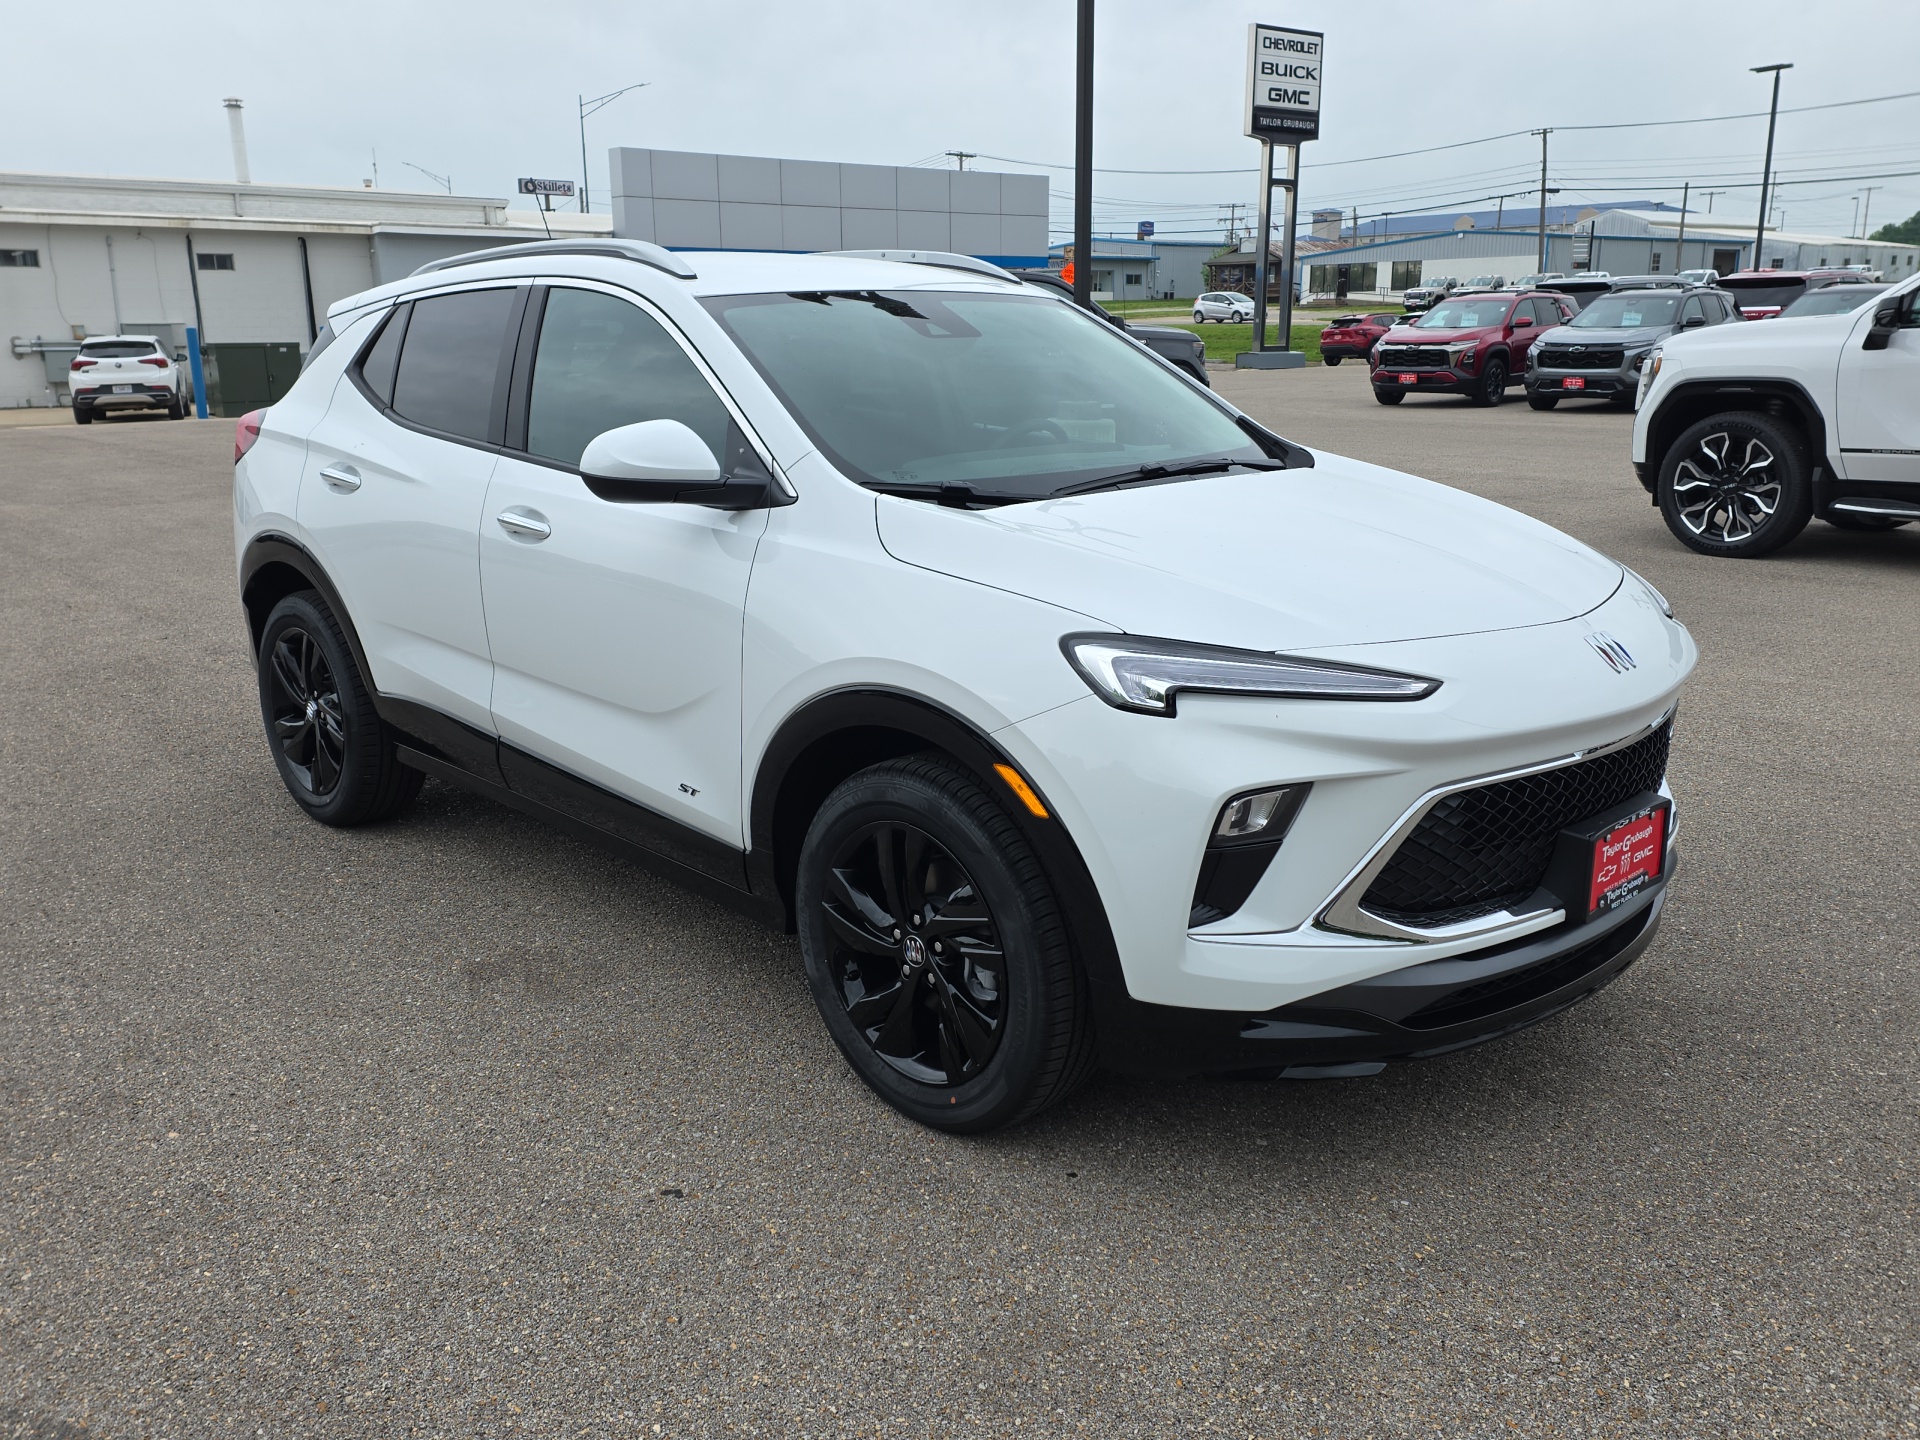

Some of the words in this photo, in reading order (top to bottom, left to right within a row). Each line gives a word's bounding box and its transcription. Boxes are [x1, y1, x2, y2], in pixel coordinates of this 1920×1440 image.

[1263, 36, 1319, 55] CHEVROLET
[1261, 61, 1318, 81] BUICK
[1268, 87, 1310, 105] GMC
[1260, 117, 1281, 127] TAYLOR
[1283, 119, 1315, 130] GRUBAUGH
[537, 181, 571, 193] Skillets
[677, 783, 701, 796] ST
[1602, 842, 1622, 863] Taylor
[1622, 825, 1653, 852] Grubaugh
[1633, 845, 1654, 862] GMC
[1607, 888, 1621, 904] Taylor
[1621, 875, 1644, 896] Grubaugh
